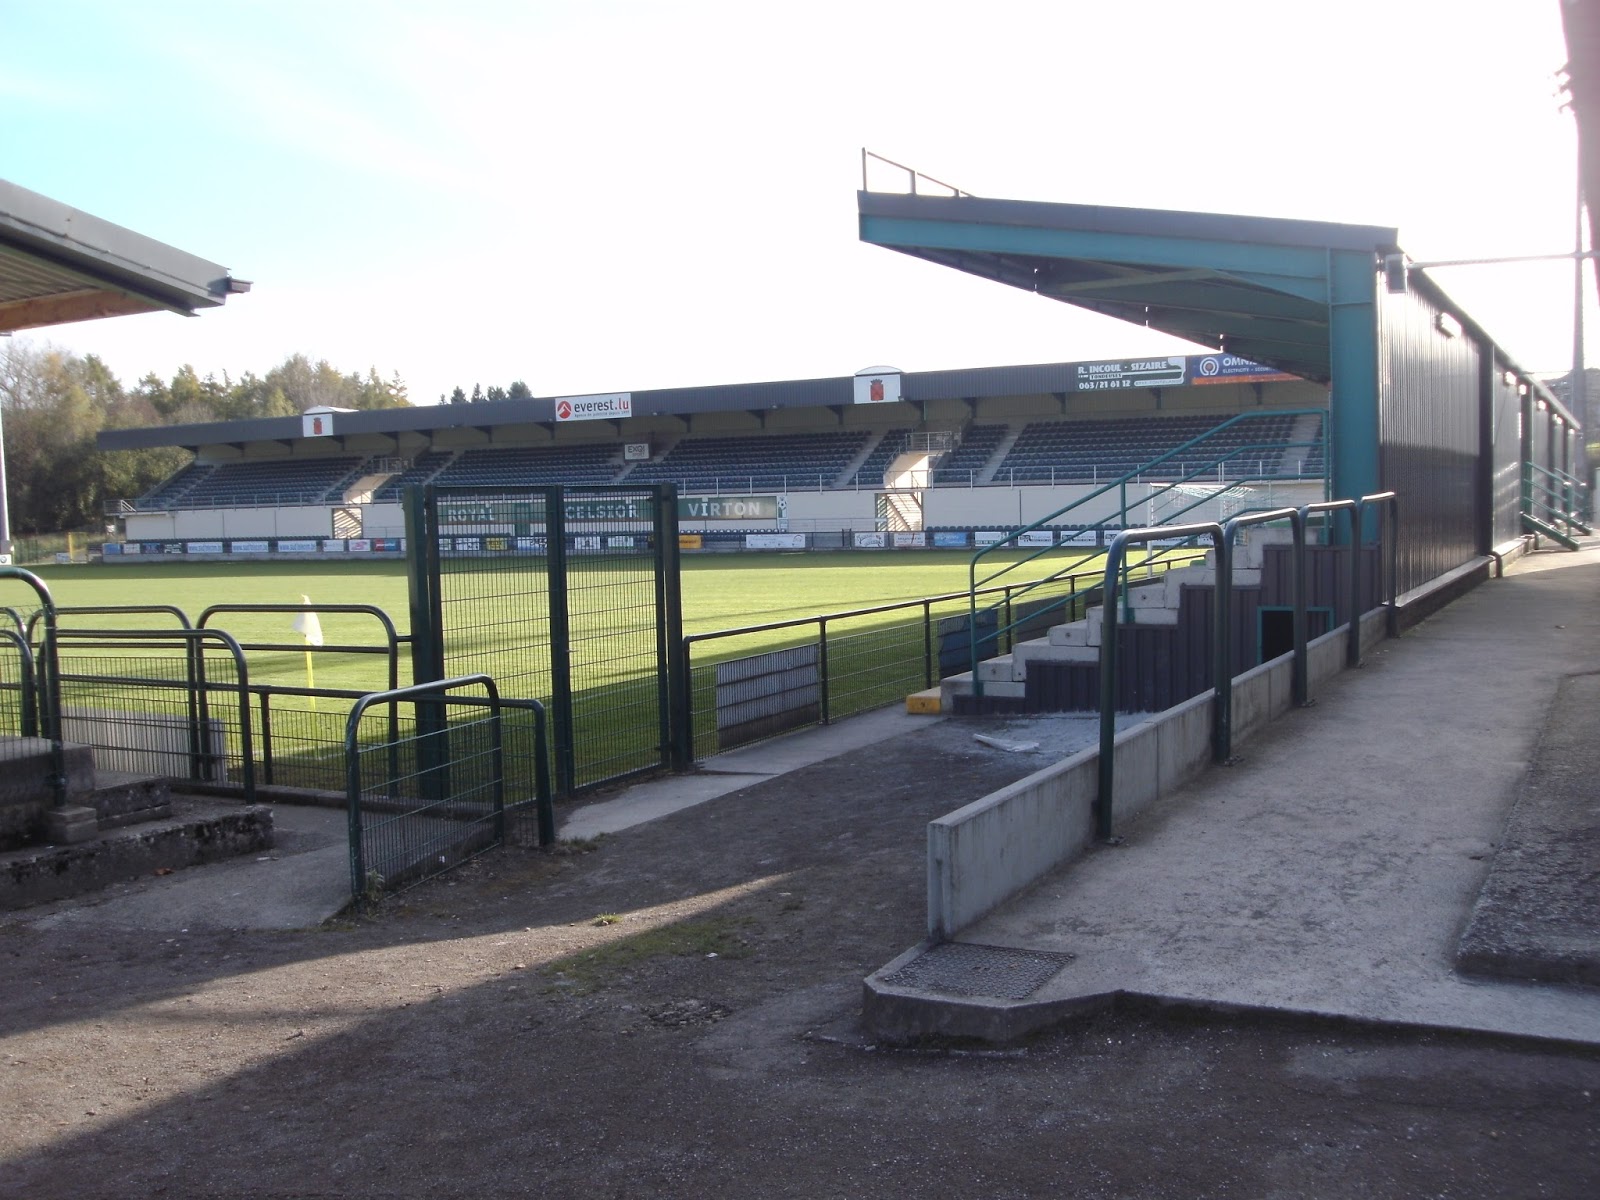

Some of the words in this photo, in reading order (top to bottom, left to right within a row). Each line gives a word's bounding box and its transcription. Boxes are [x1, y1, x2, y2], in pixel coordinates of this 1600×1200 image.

[1078, 366, 1088, 374] R.
[1089, 364, 1121, 374] INCOUL
[1130, 361, 1167, 371] SIZAIRE
[1222, 357, 1257, 366] OMN
[1122, 379, 1131, 387] 12
[574, 397, 629, 412] everest.lu
[447, 508, 495, 521] ROYAL
[564, 504, 639, 519] CELSIOR
[688, 502, 760, 517] VIRTON
